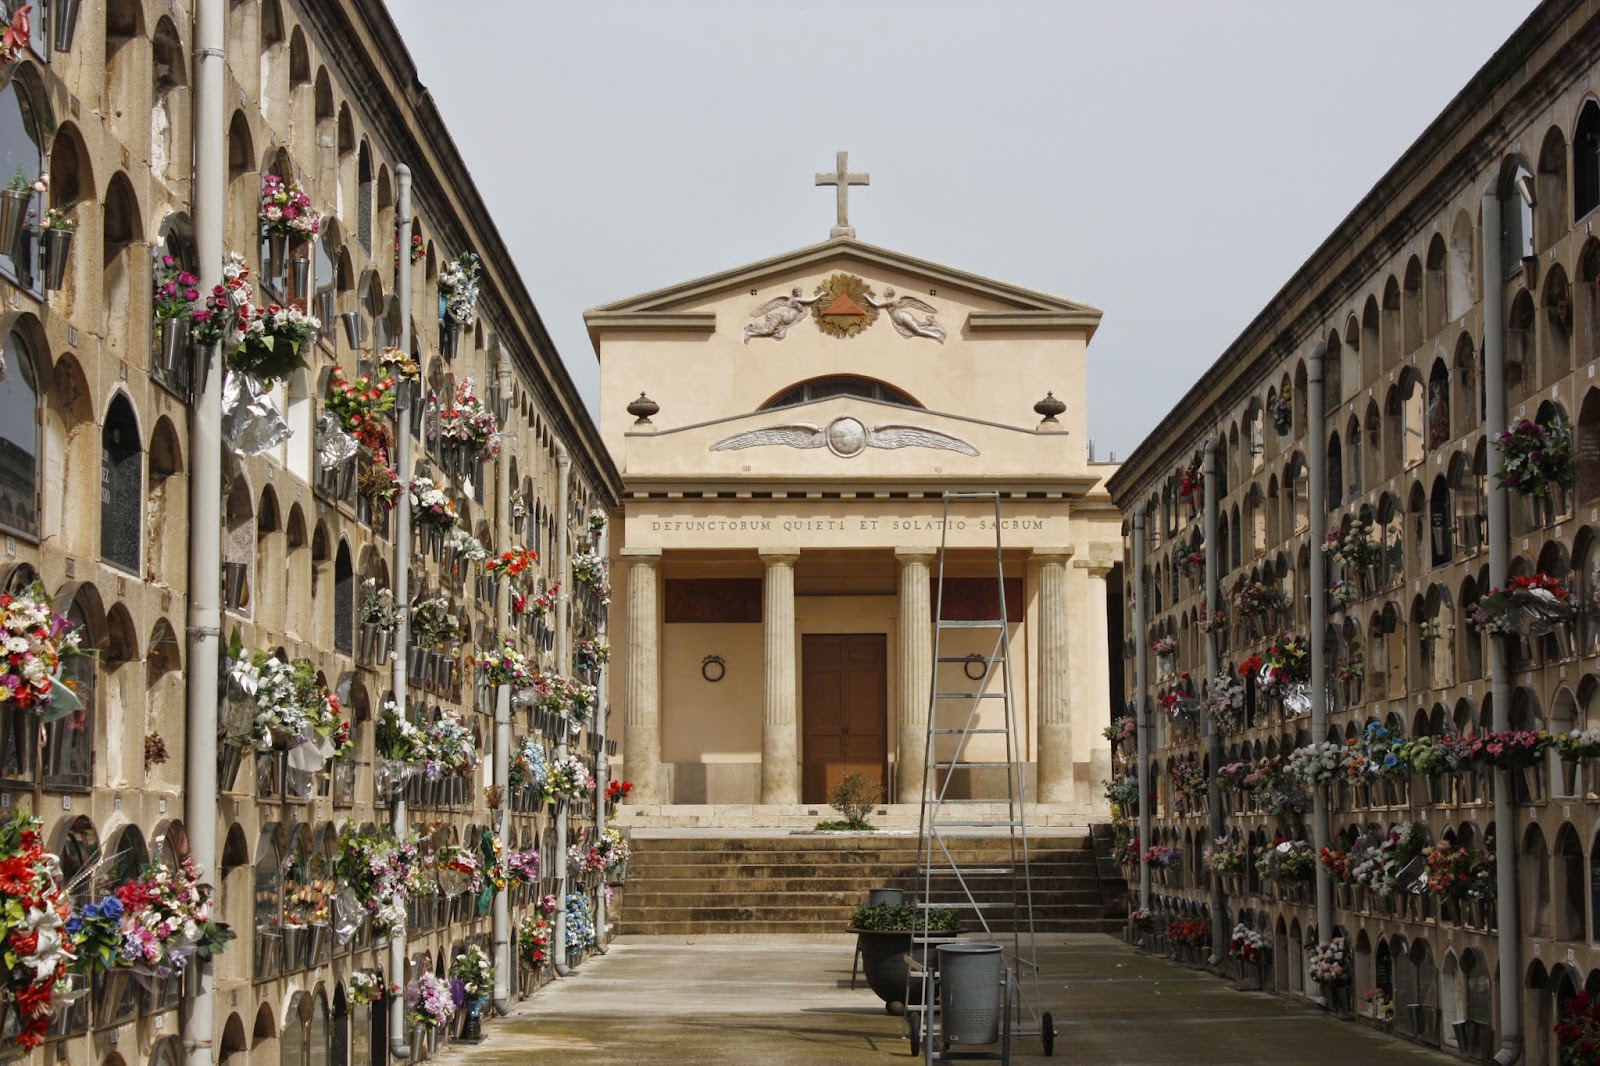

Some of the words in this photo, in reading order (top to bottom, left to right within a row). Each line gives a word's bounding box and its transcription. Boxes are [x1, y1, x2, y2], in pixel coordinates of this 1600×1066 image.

[652, 521, 771, 531] DEFUNCTORUM
[783, 520, 845, 532] QUIETI
[860, 520, 879, 530] ET
[893, 520, 966, 531] SOLATIO
[979, 520, 1043, 530] SACRUM
